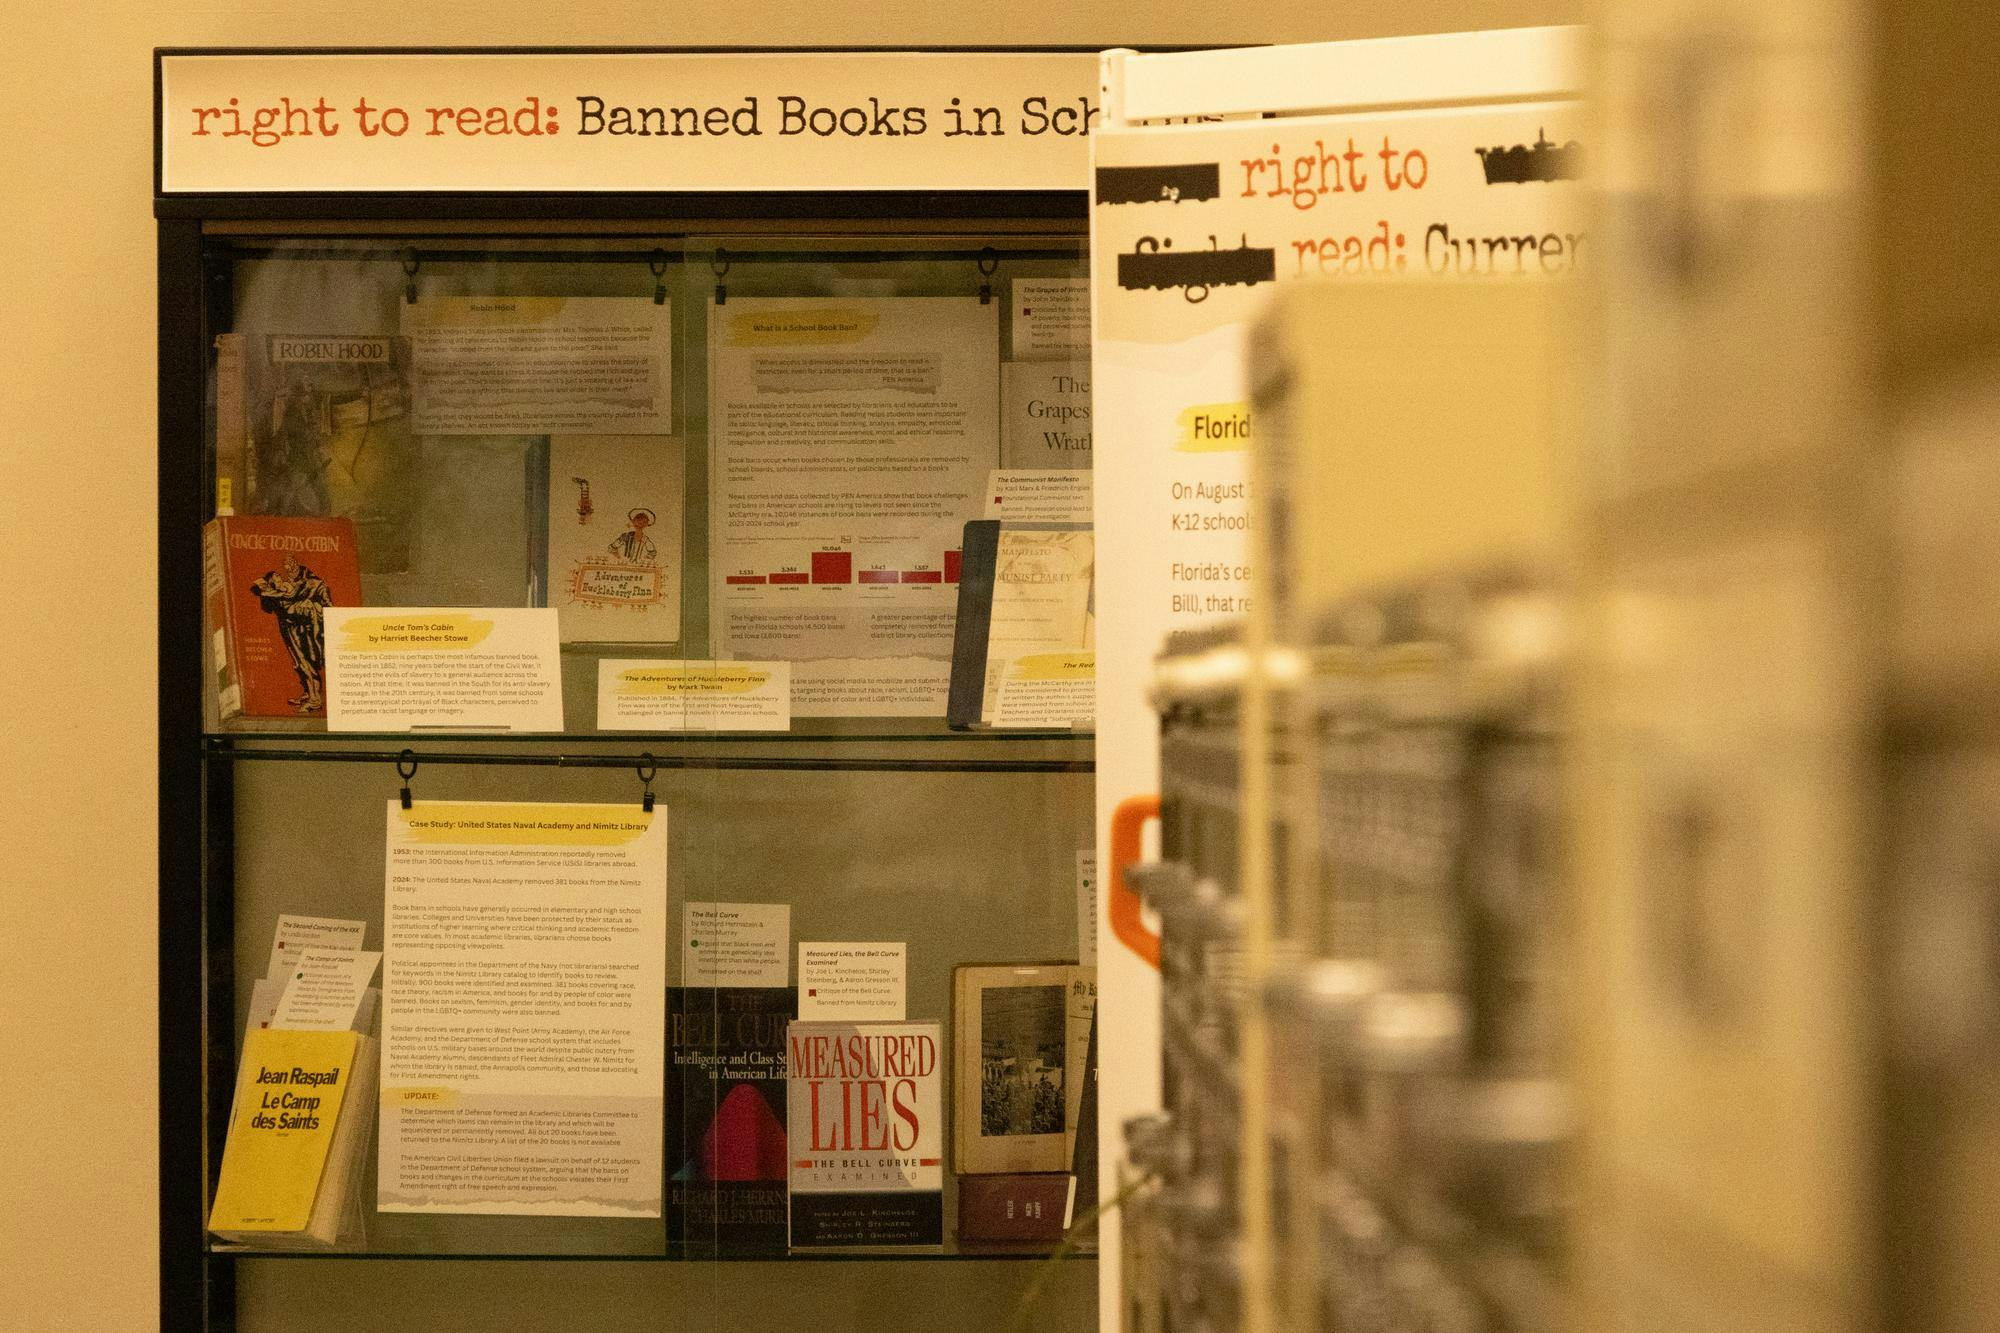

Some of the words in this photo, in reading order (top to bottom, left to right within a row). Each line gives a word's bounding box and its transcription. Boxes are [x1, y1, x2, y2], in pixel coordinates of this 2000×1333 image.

[192, 96, 339, 147] right
[353, 97, 409, 137] to
[425, 96, 560, 137] read:
[576, 97, 760, 137] Banned
[778, 96, 927, 137] Books
[944, 97, 1005, 136] in
[1020, 96, 1101, 137] Sch
[1240, 136, 1368, 211] right
[1378, 135, 1429, 191] to
[1291, 219, 1406, 277] read:
[280, 342, 335, 360] ROBIN
[339, 342, 383, 359] HOOD
[1051, 375, 1090, 394] The
[1027, 399, 1091, 424] Grapes
[1172, 482, 1192, 499] On
[1196, 482, 1245, 503] August
[1172, 514, 1200, 531] K-12
[594, 571, 643, 581] Adventures
[1172, 563, 1230, 581] Florida's
[633, 586, 652, 596] Finn
[1172, 595, 1202, 615] Bill),
[1207, 595, 1234, 612] that
[368, 635, 379, 643] by
[409, 820, 428, 828] Case
[429, 820, 455, 830] Study:
[457, 820, 484, 828] United
[486, 821, 511, 829] States
[512, 821, 536, 829] Naval
[537, 821, 574, 832] Academy
[575, 822, 591, 830] and
[592, 822, 618, 830] Nimitz
[619, 822, 648, 833] Library
[719, 911, 739, 919] Curve
[838, 950, 853, 958] Lies,
[674, 1052, 727, 1070] Intelligence
[729, 1052, 747, 1065] and
[749, 1052, 773, 1065] Class
[790, 1035, 936, 1079] MEASURED
[256, 1067, 288, 1085] Jean
[290, 1067, 340, 1086] Raspail
[709, 1067, 718, 1079] in
[721, 1067, 767, 1079] American
[261, 1092, 279, 1109] Le
[281, 1092, 320, 1112] Camp
[252, 1112, 275, 1129] des
[277, 1112, 319, 1131] Saints
[808, 1080, 920, 1152] LIES
[813, 1159, 835, 1168] THE
[842, 1159, 871, 1168] BELL
[878, 1159, 918, 1168] CURVE
